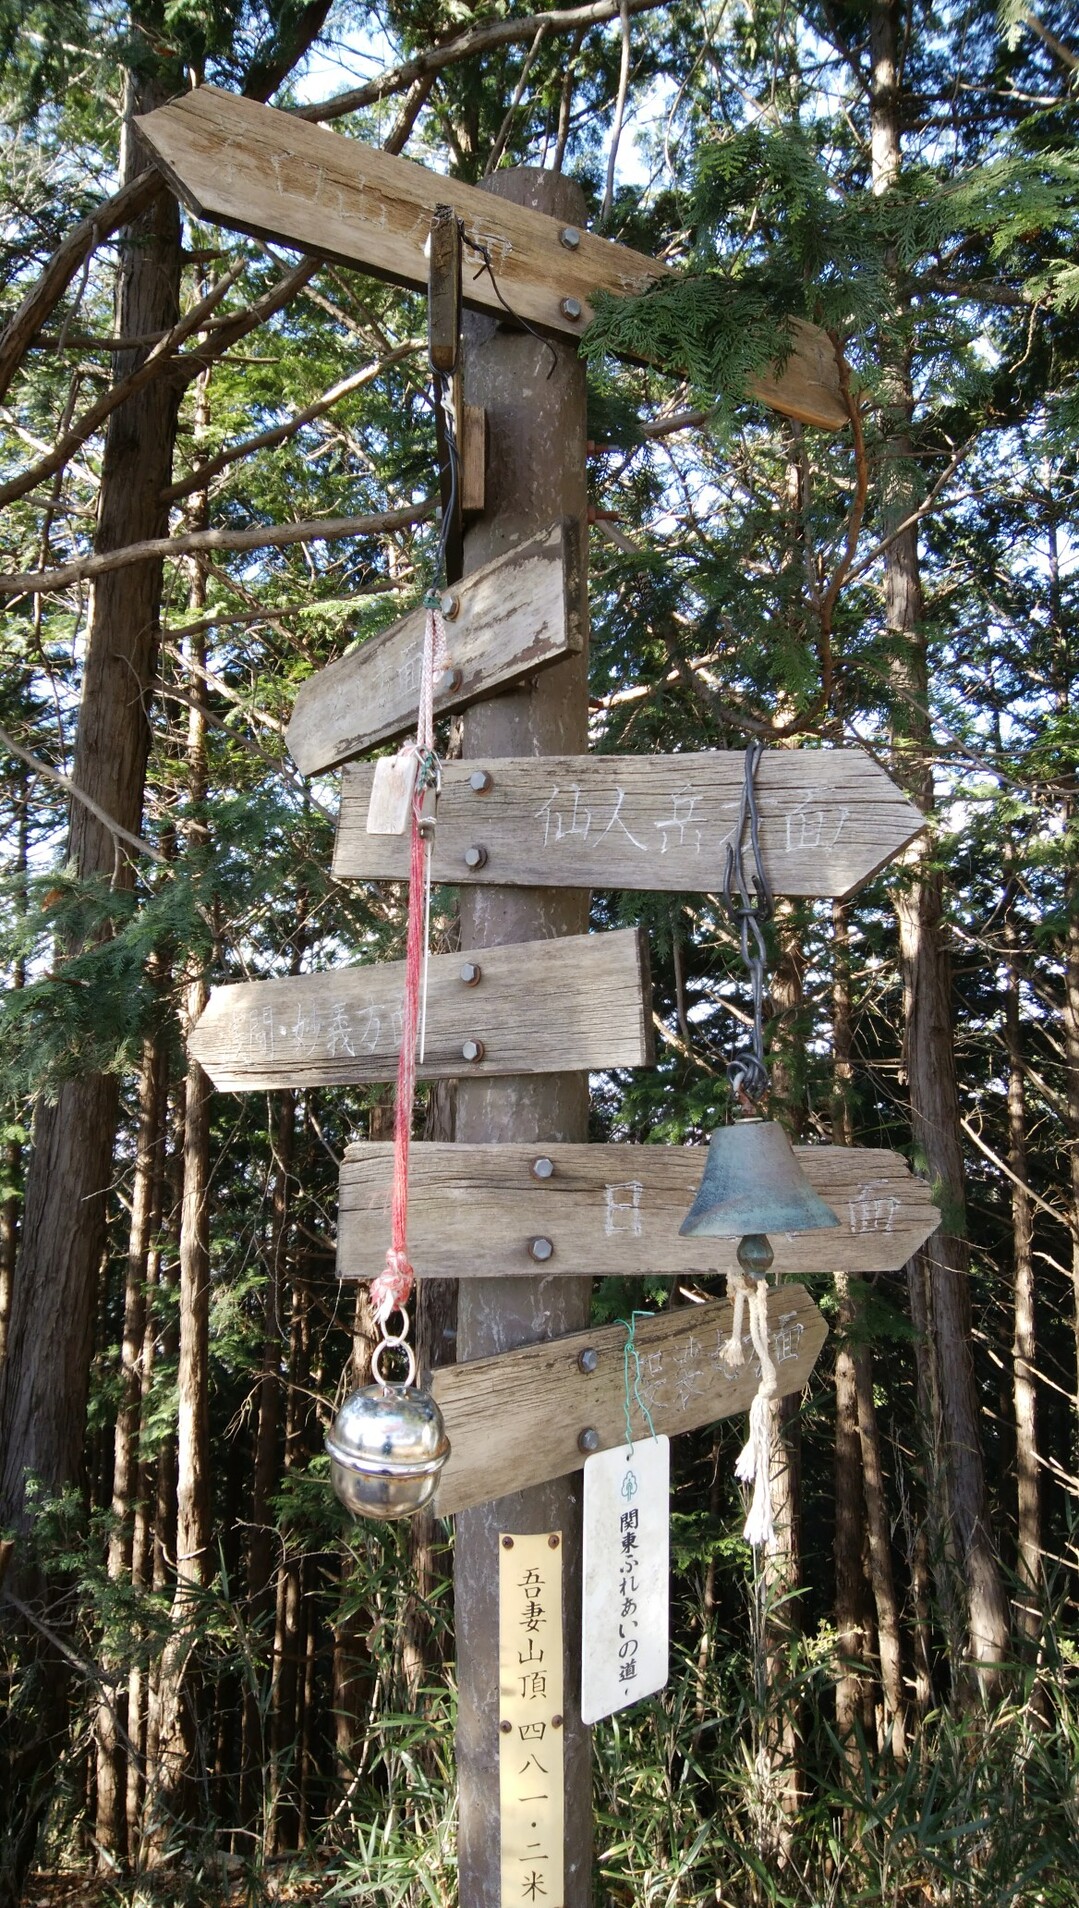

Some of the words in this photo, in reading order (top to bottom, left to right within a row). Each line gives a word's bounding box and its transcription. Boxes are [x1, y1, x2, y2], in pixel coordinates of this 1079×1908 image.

[604, 1178, 901, 1241] 日面
[517, 1567, 548, 1700] 吾妻山頂
[617, 1508, 640, 1682] 関東ふれあいの道
[518, 1721, 549, 1903] 四八一・二米
